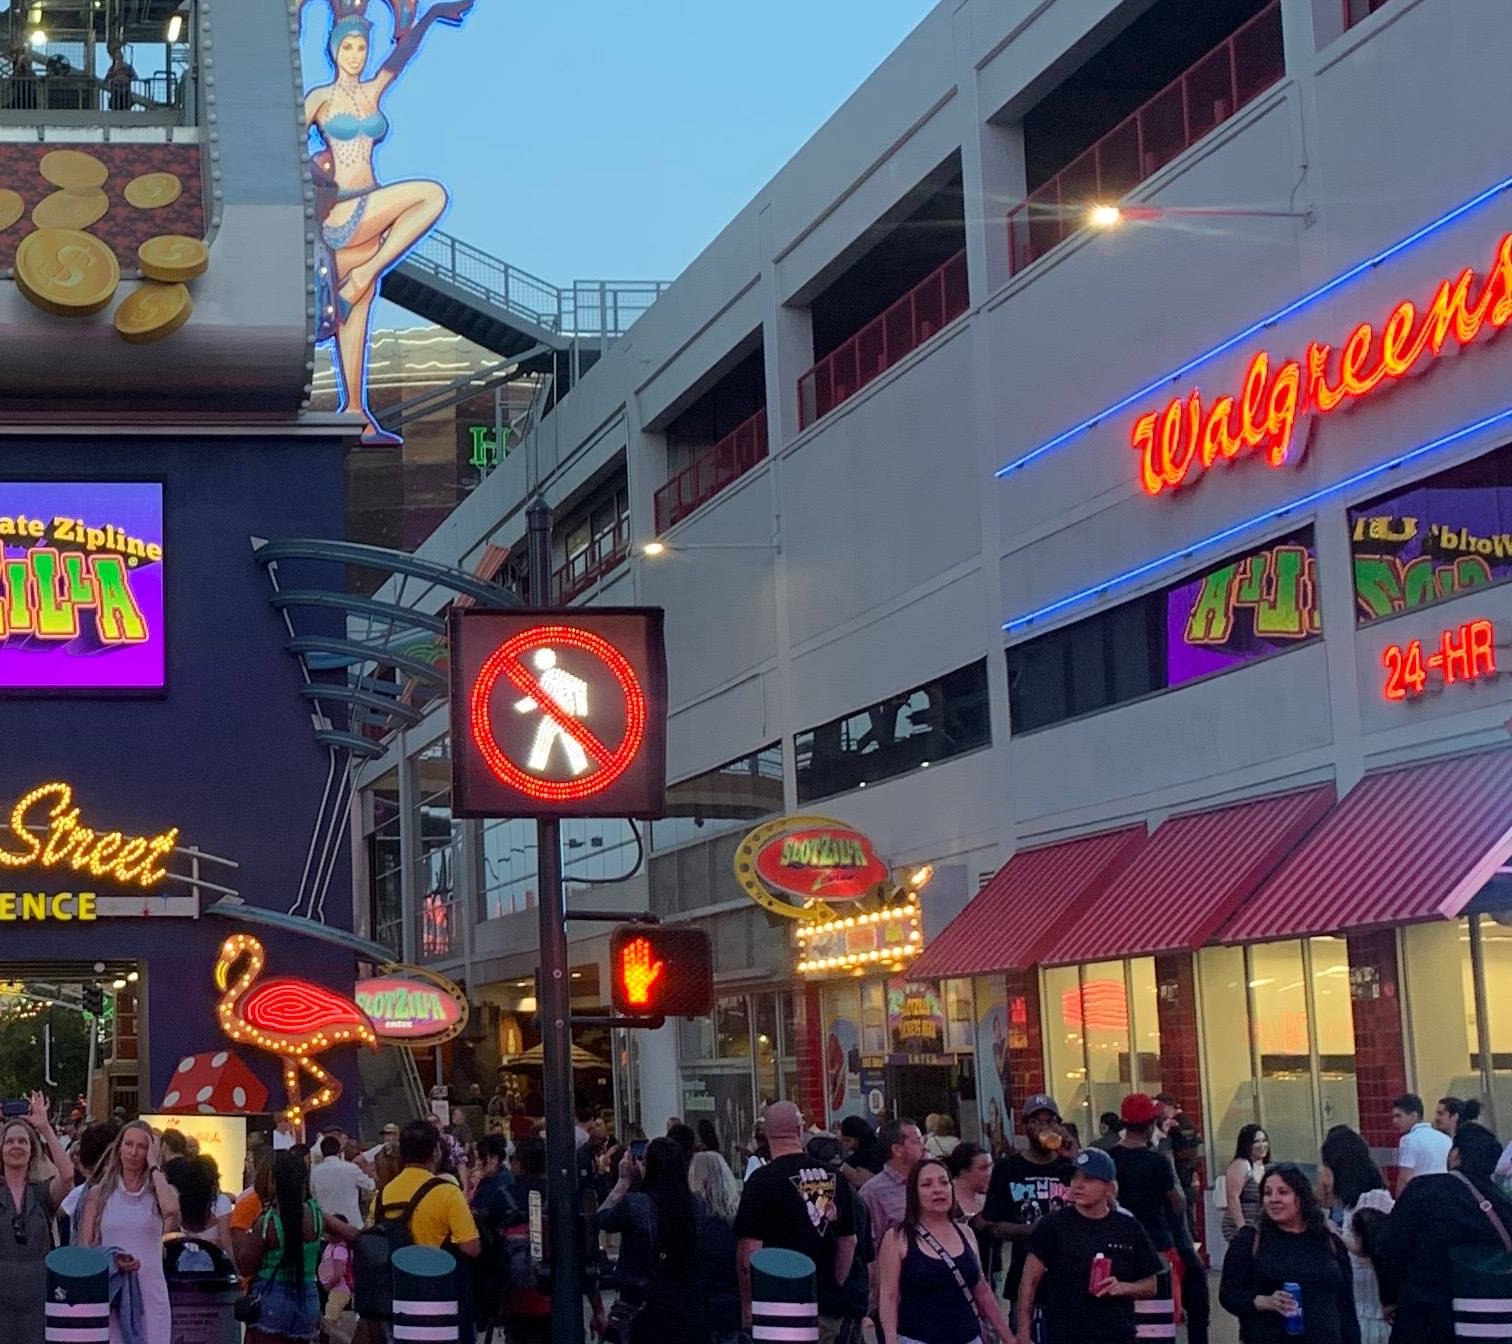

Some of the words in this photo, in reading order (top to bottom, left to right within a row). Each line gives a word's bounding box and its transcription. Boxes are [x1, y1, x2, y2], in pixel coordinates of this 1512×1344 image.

[1131, 231, 1512, 498] Walgreens
[53, 515, 163, 563] Zipline
[1384, 619, 1496, 702] 24-HR
